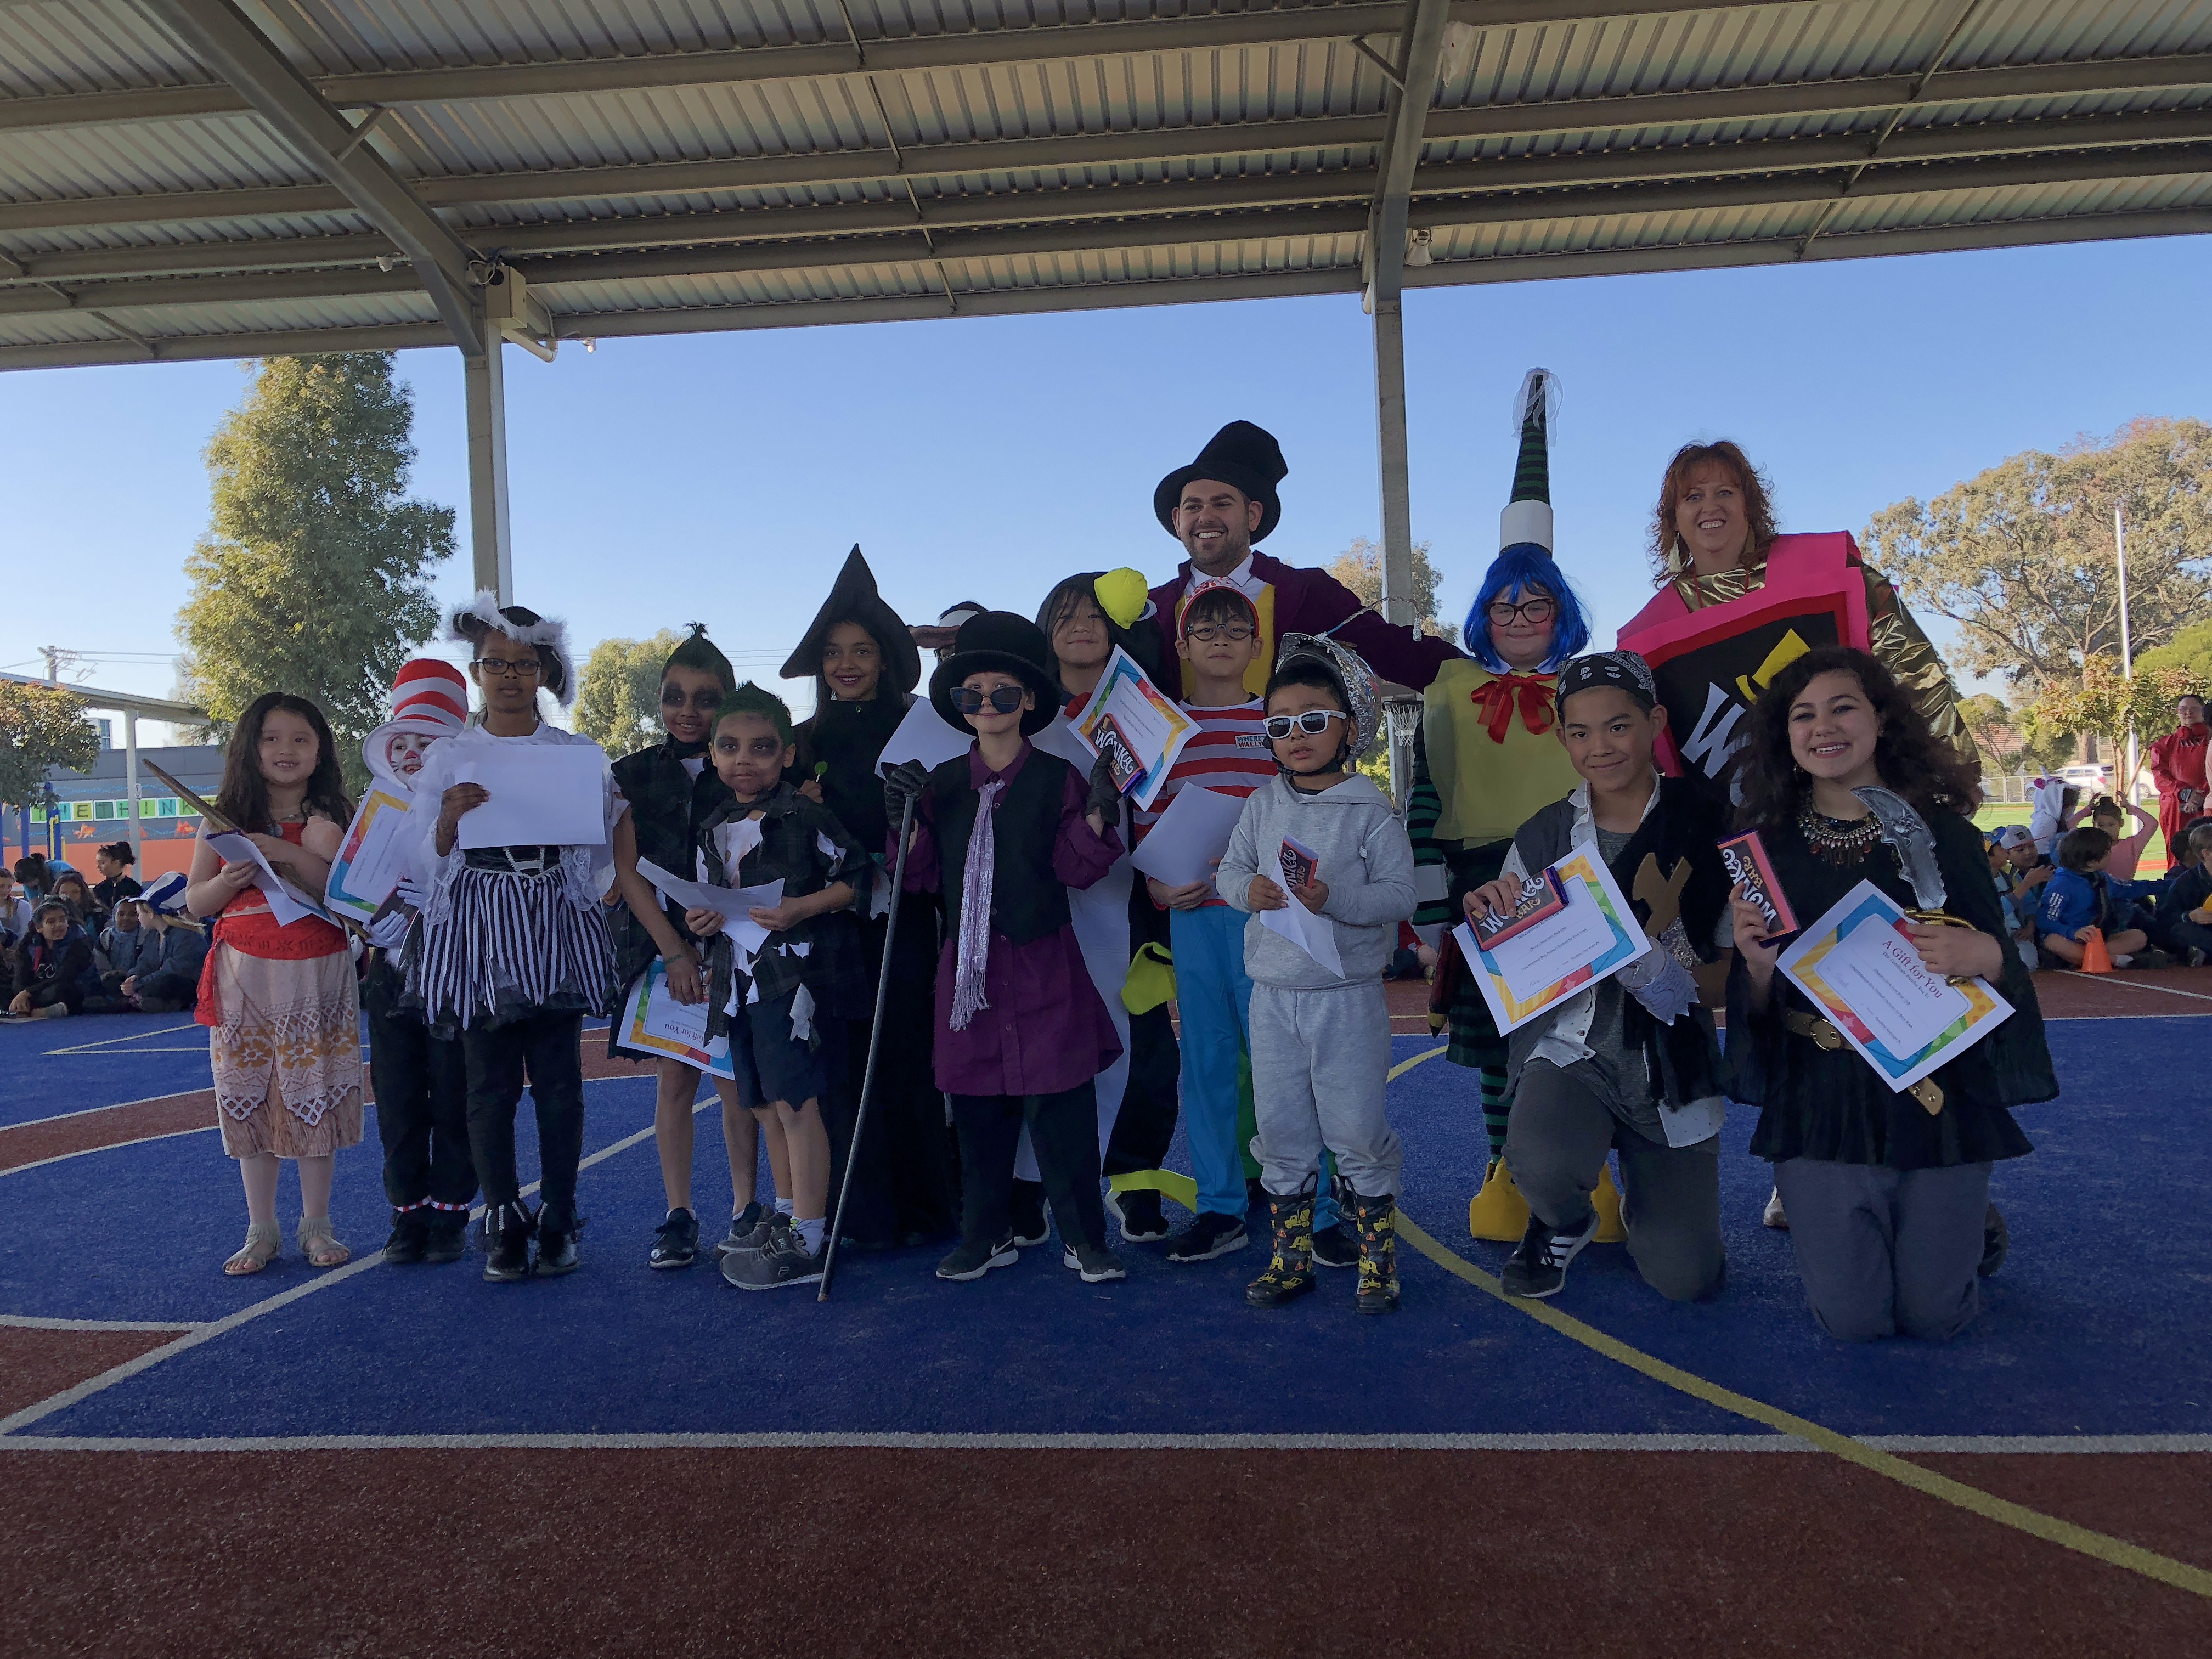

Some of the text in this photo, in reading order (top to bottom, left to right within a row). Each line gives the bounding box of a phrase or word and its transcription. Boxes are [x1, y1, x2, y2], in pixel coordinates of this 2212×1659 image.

[1109, 759, 1120, 776] AR
[1742, 855, 1764, 889] BAR
[1516, 898, 1541, 919] BAR
[1882, 940, 1893, 950] A
[1892, 947, 1911, 967] Gift
[1909, 964, 1925, 979] for
[1924, 978, 1943, 998] You
[664, 1024, 679, 1034] You
[681, 1029, 691, 1039] for
